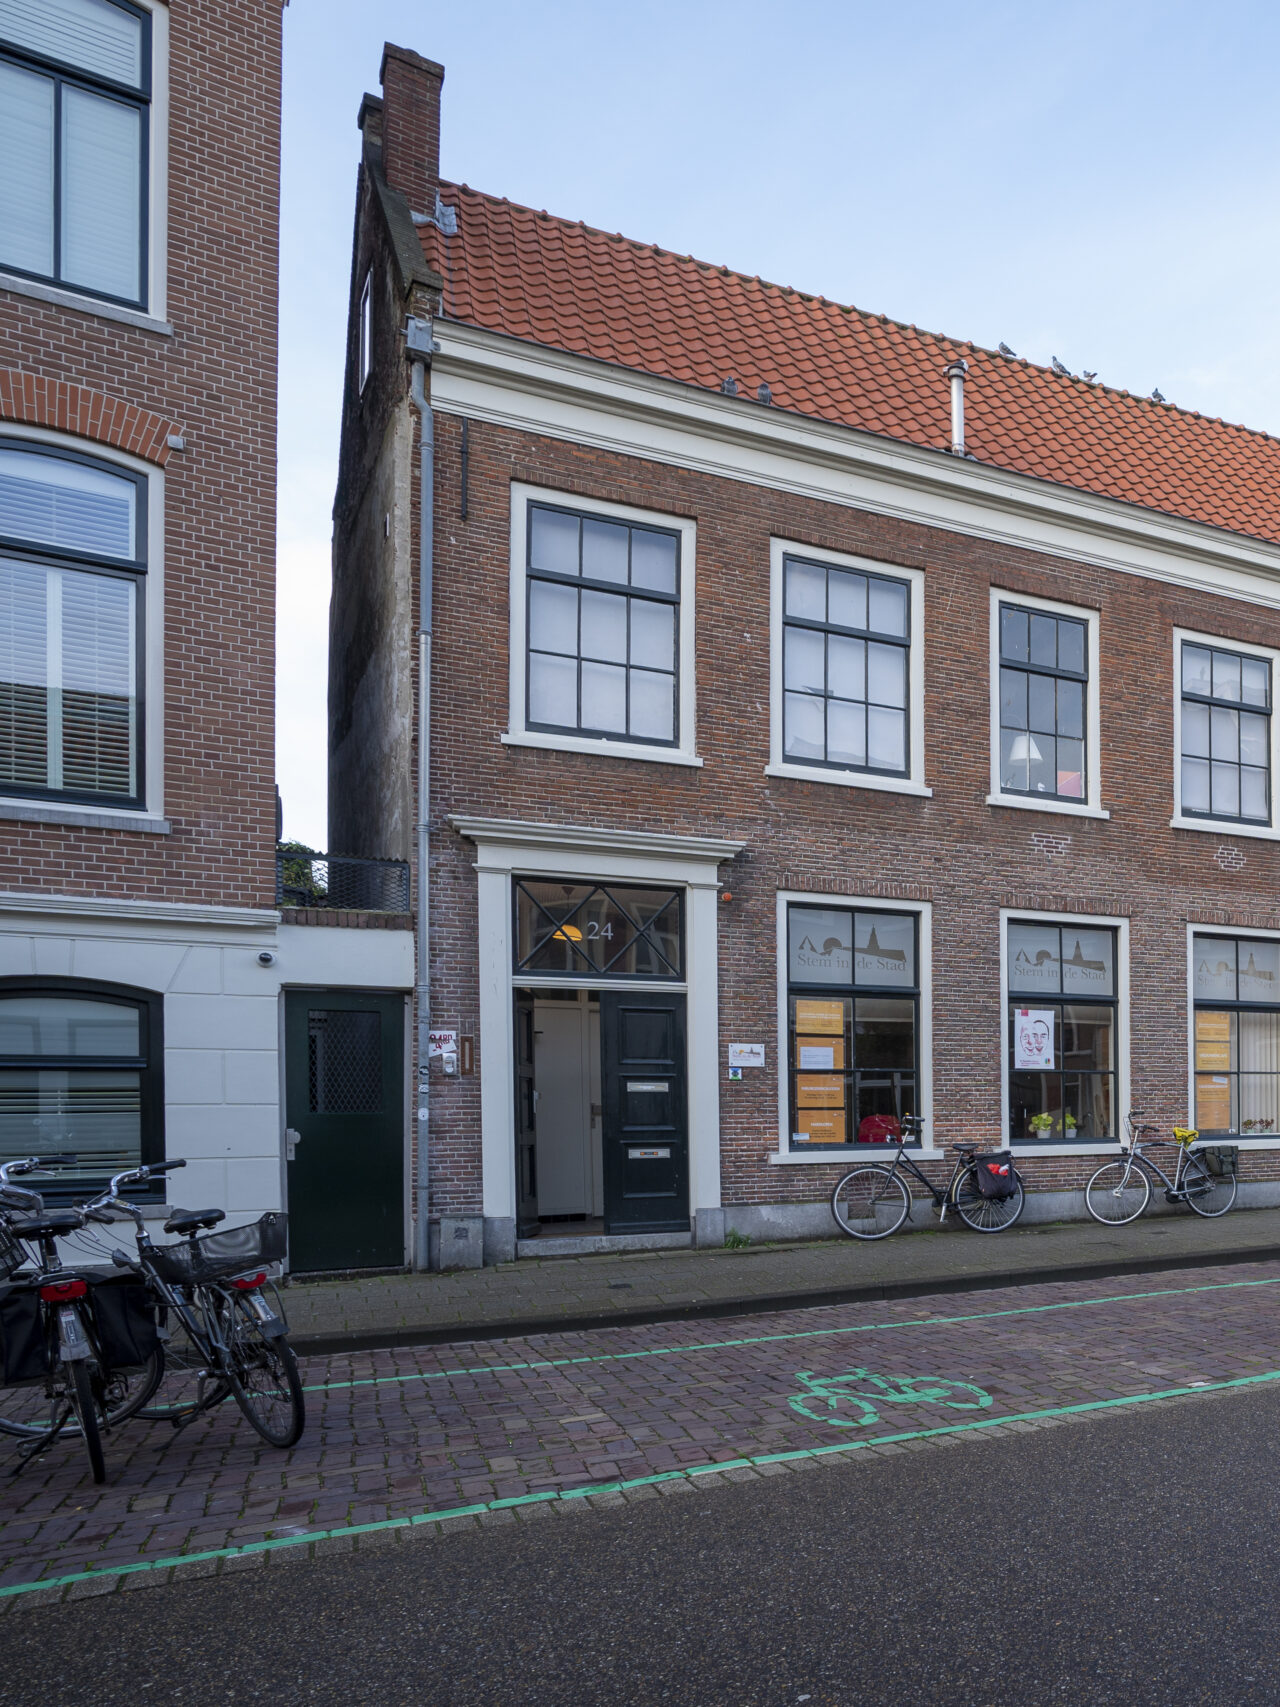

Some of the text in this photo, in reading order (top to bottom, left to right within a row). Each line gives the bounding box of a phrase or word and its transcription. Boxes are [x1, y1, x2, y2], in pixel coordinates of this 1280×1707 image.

[587, 921, 614, 941] 24
[797, 953, 906, 972] Stem in de Stad
[1014, 965, 1105, 981] Stem in de Stad
